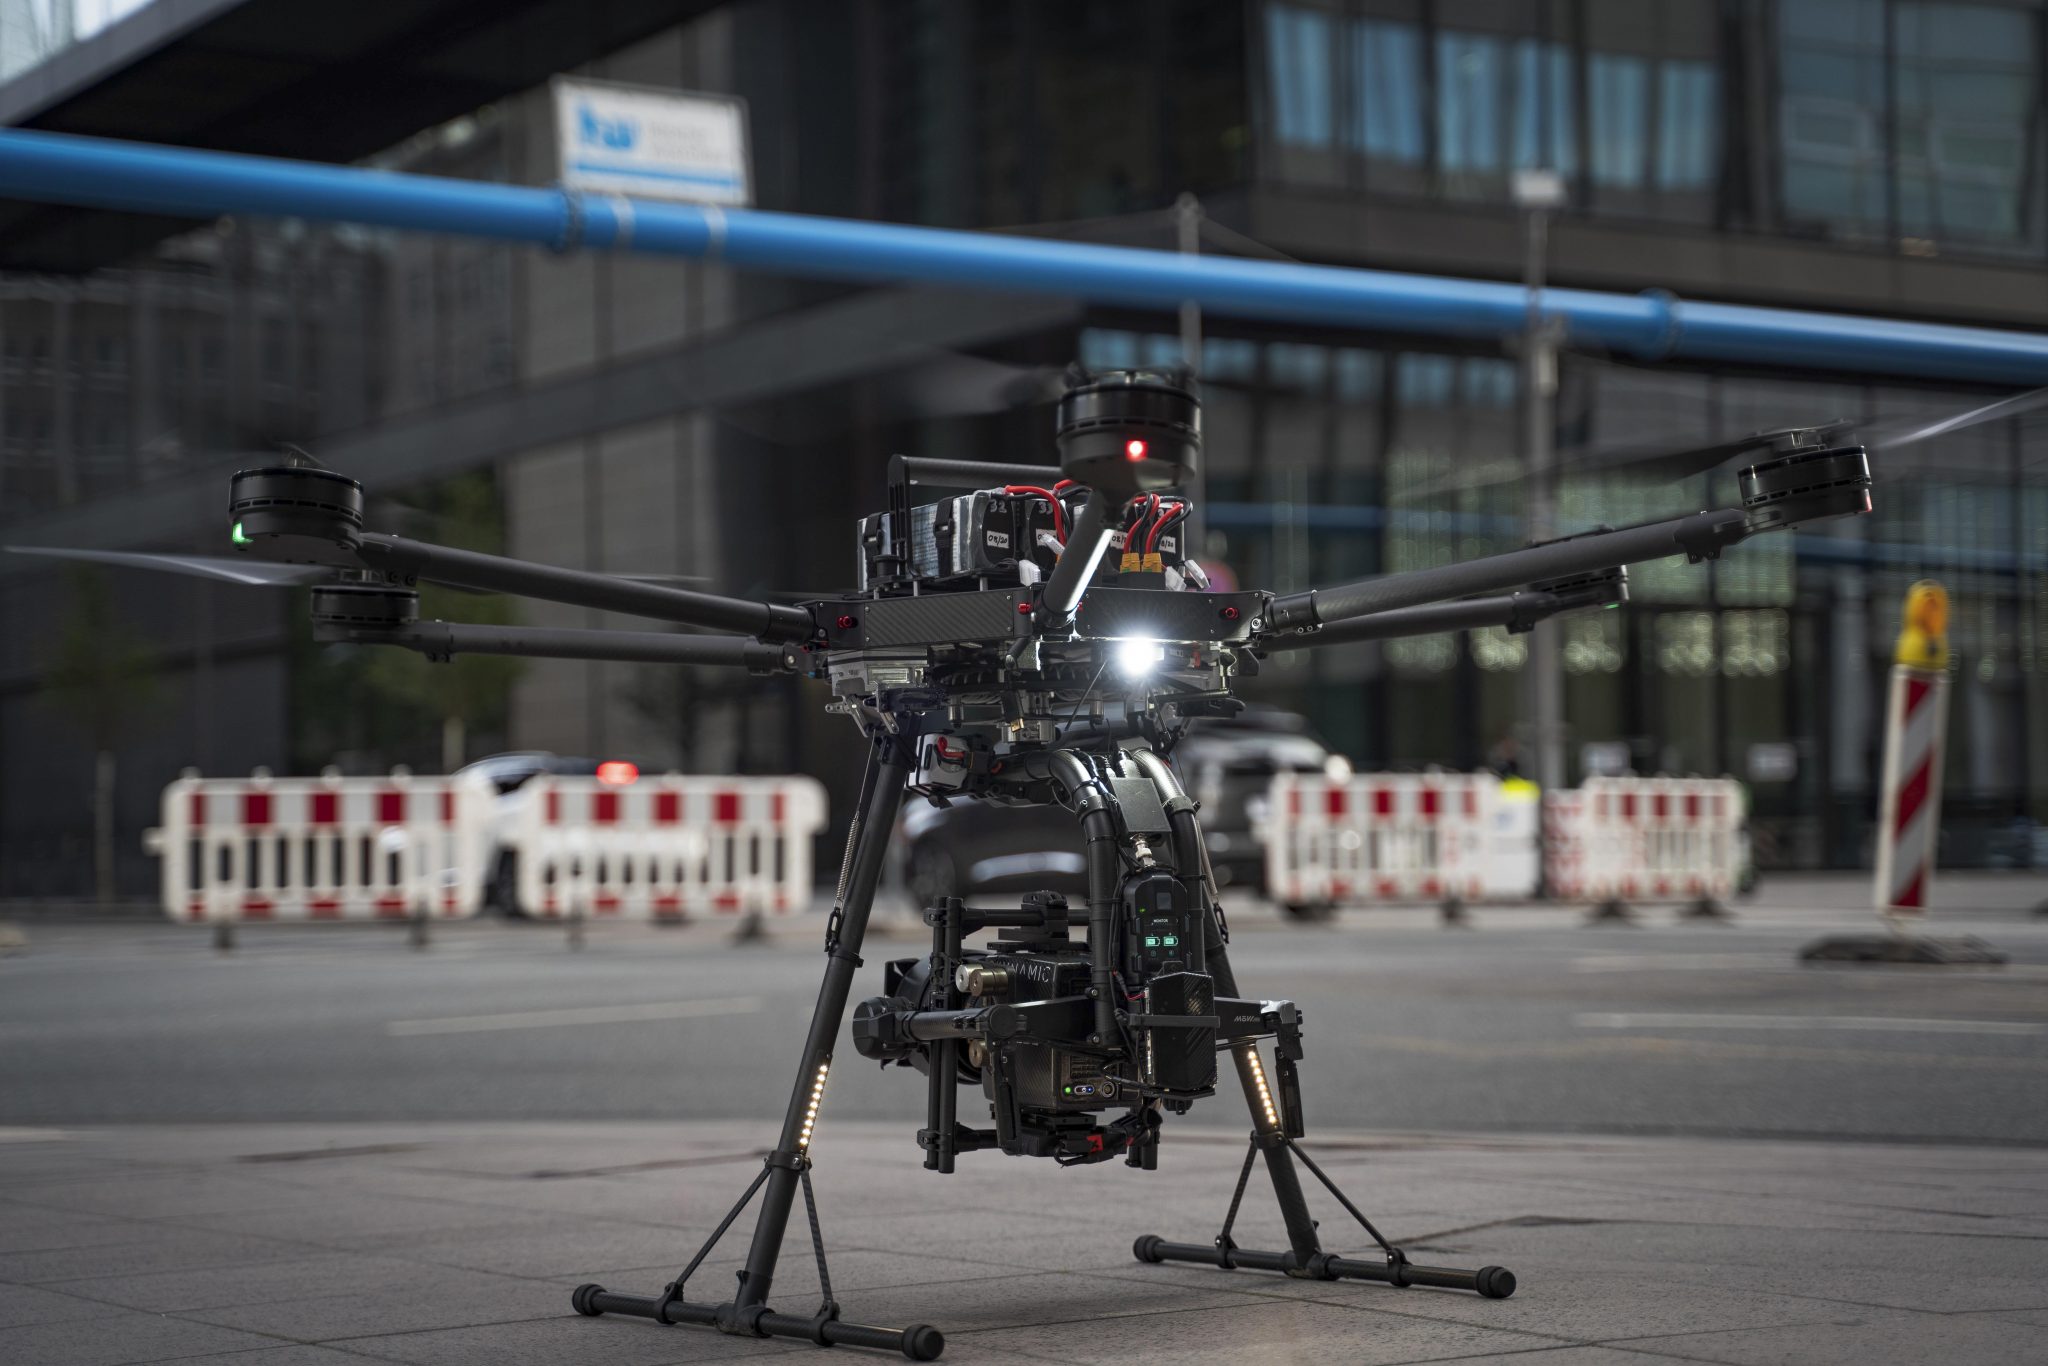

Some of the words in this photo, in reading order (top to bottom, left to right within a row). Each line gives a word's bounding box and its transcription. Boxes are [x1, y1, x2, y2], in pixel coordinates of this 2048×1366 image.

[990, 499, 1007, 513] 32
[988, 534, 1008, 546] 08/20
[997, 961, 1051, 983] NAMIC
